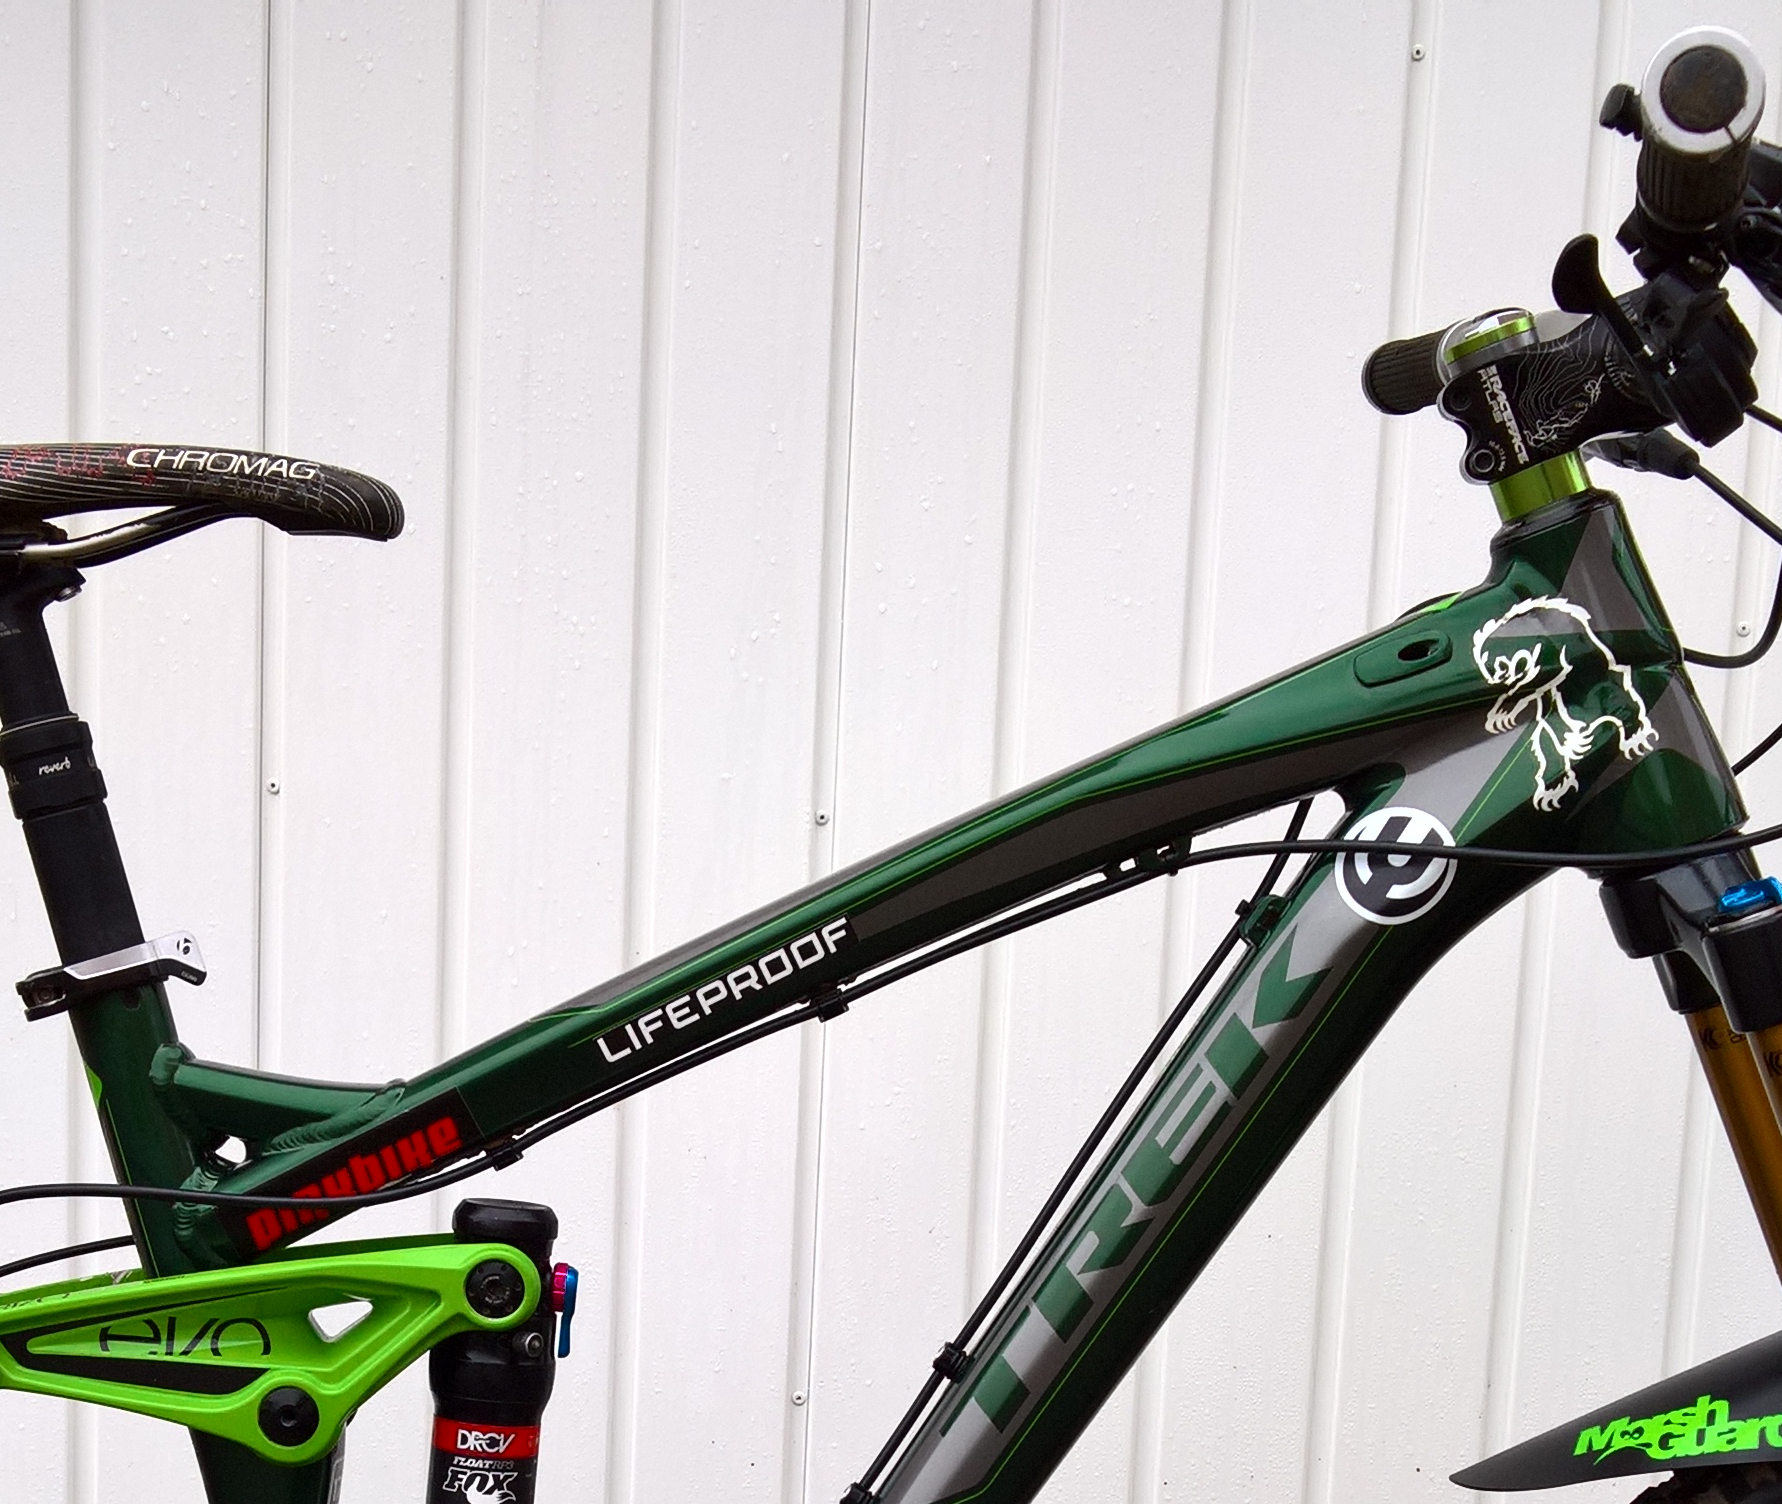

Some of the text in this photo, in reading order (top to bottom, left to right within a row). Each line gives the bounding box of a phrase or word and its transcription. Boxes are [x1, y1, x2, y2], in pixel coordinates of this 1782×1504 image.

[127, 446, 318, 482] CHROMAG
[596, 917, 849, 1064] LIFEPROOF
[940, 924, 1333, 1438] TREK
[99, 1316, 272, 1357] evo
[457, 1429, 516, 1453] DRCV
[1573, 1394, 1730, 1464] Marsh
